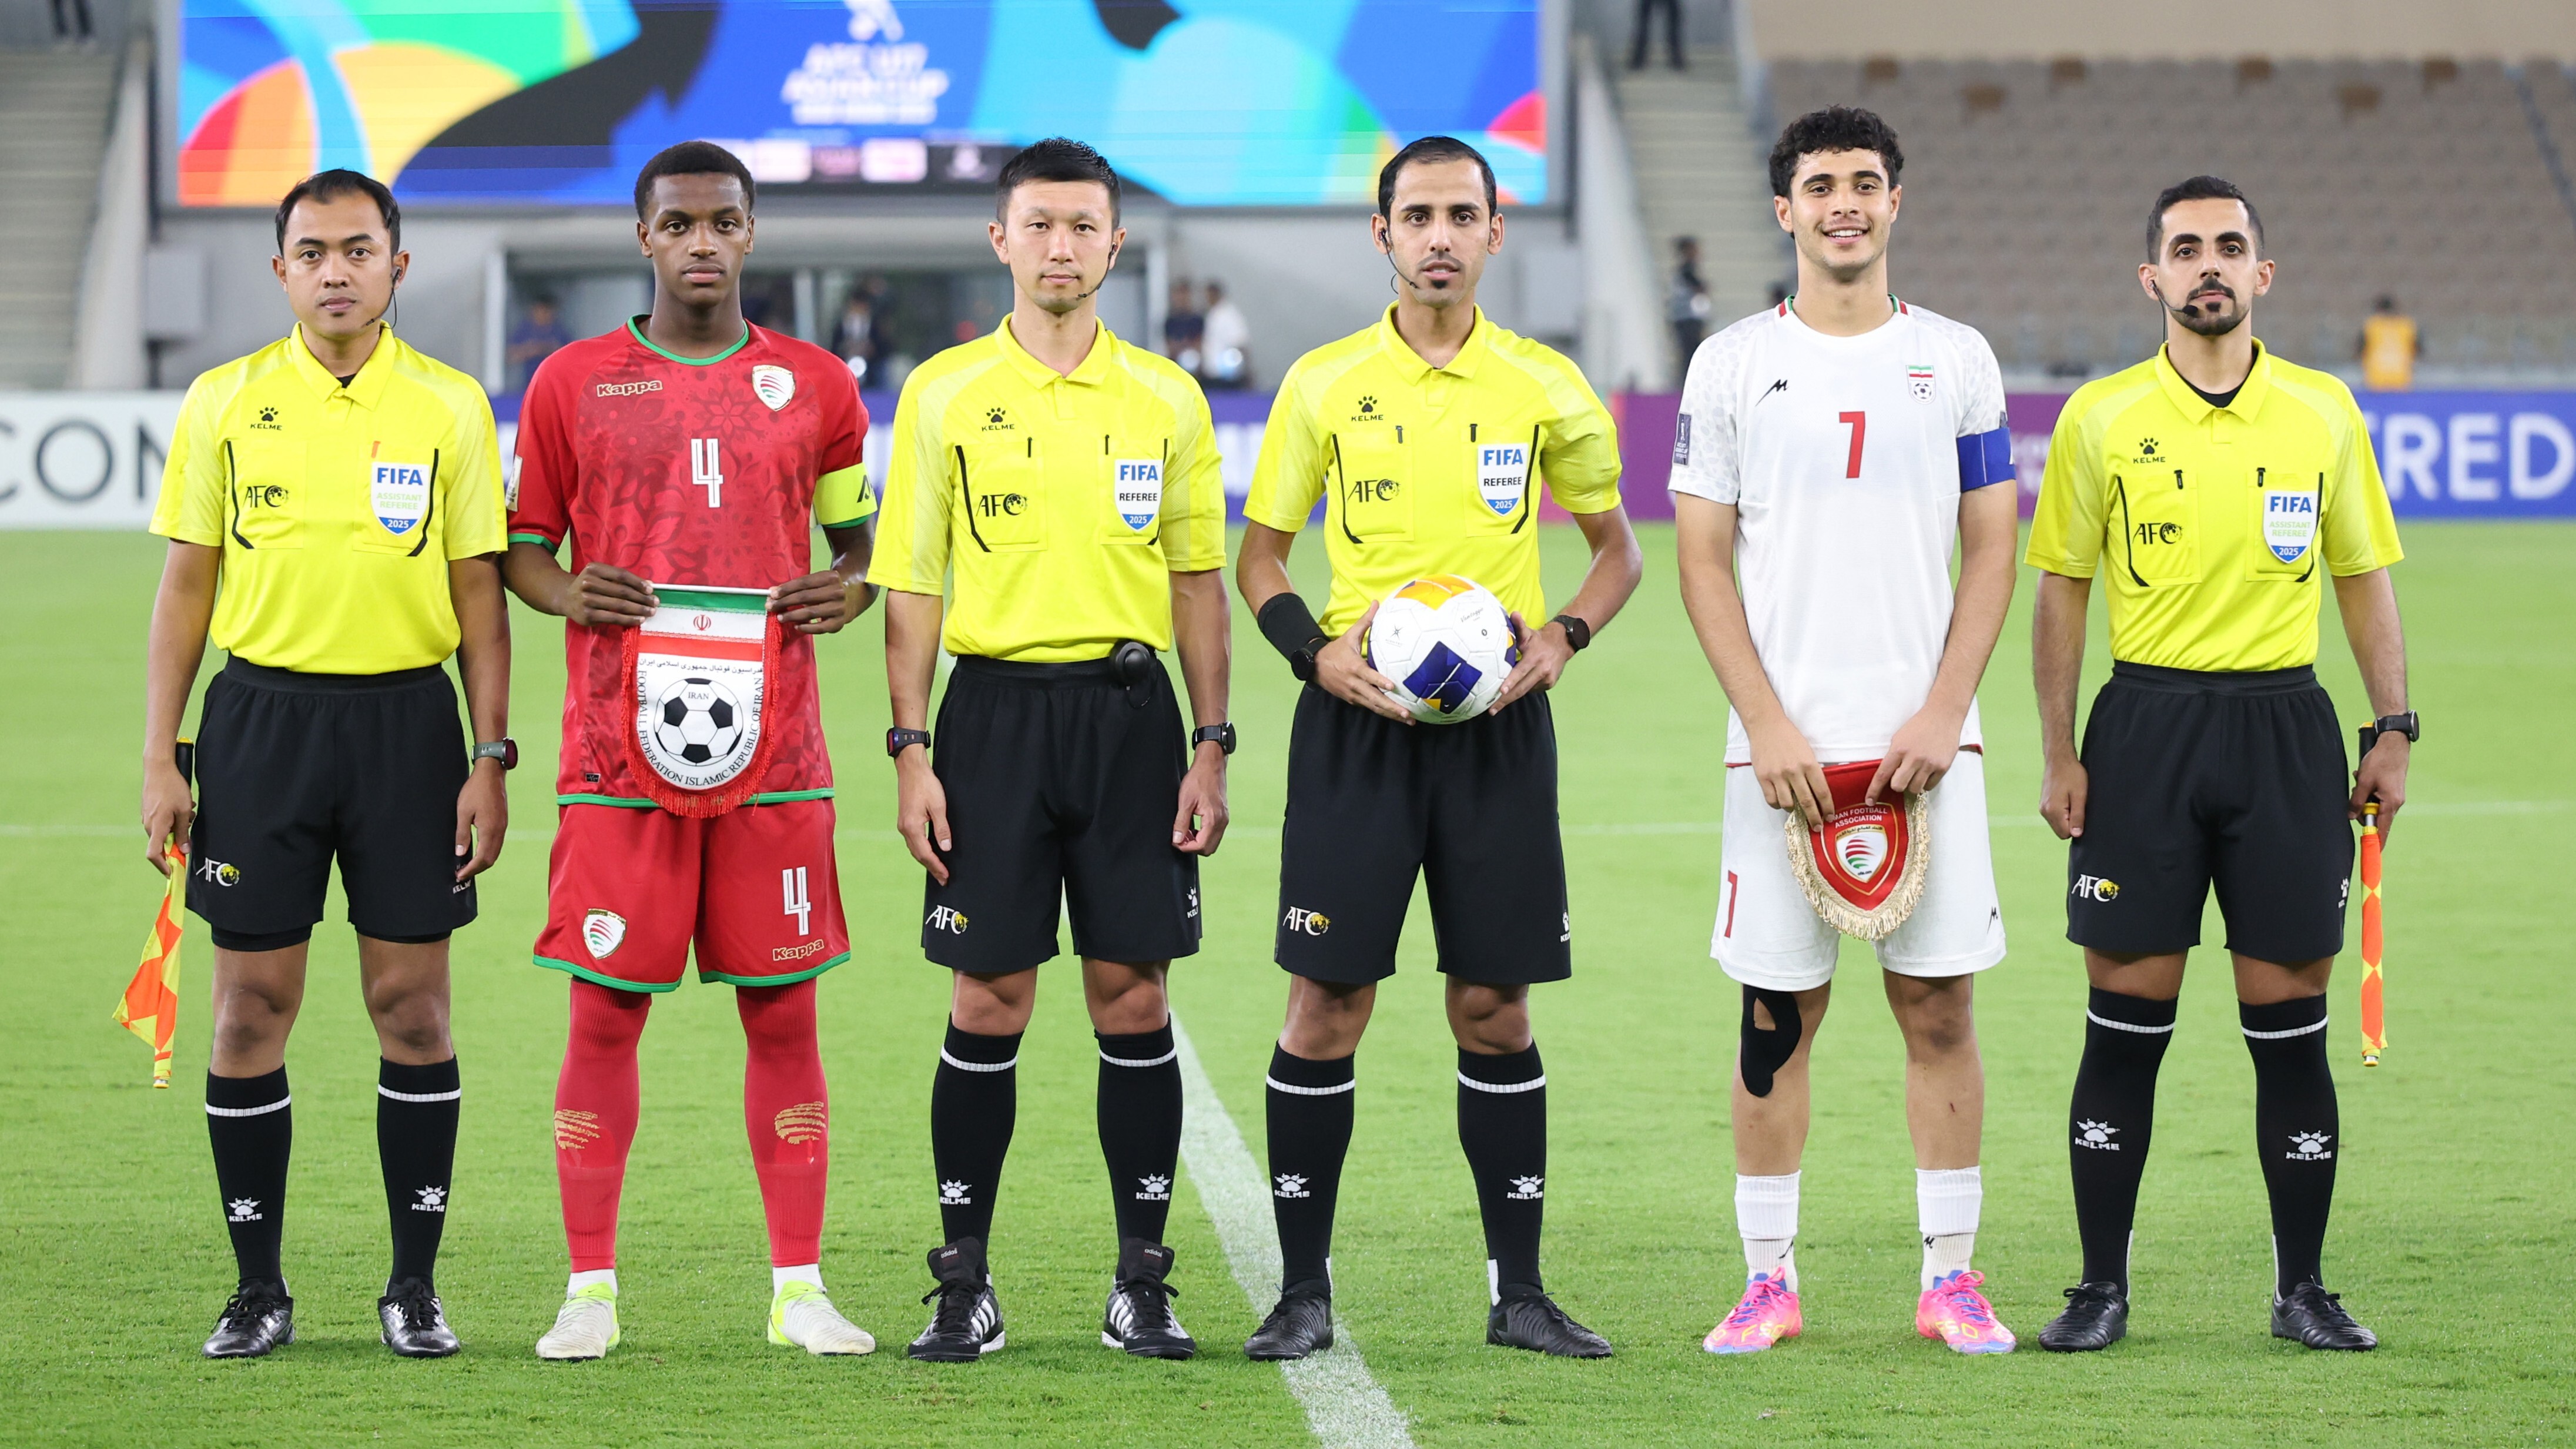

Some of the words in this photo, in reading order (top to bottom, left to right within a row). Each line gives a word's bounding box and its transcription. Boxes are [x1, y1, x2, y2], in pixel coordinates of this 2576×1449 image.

[597, 380, 663, 397] Kappa
[1838, 411, 1866, 479] 7
[1483, 449, 1523, 466] FIFA
[2364, 410, 2575, 501] RED
[377, 467, 424, 486] FIFA
[691, 438, 723, 508] 4
[1120, 464, 1158, 481] FIFA
[1483, 476, 1522, 487] REFEREE
[243, 485, 289, 508] AFC
[376, 492, 423, 501] ASSISTANT
[1119, 493, 1157, 501] REFEREE
[1347, 478, 1401, 503] AFC
[380, 500, 418, 510] REFEREE
[976, 493, 1028, 517] AFC
[1494, 500, 1513, 510] 2025
[2270, 496, 2312, 513] FIFA
[387, 519, 409, 528] 2025
[1128, 516, 1147, 524] 2025
[2269, 521, 2311, 529] ASSISTANT
[2132, 522, 2183, 545] AFC
[2272, 529, 2307, 537] REFEREE
[2278, 547, 2299, 556] 2025
[637, 670, 648, 727] FOOTBALL
[688, 691, 709, 700] IRAN
[753, 676, 764, 705] IRAN
[751, 706, 762, 722] OF
[639, 729, 684, 784] FEDERATION
[729, 724, 759, 773] REPUBLIC
[685, 769, 731, 787] ISLAMIC
[1834, 811, 1848, 821] MAN
[1850, 807, 1888, 816] FOOTBALL
[1835, 815, 1882, 829] ASSOCIATION
[195, 856, 240, 887] AFC
[2071, 874, 2120, 902] AFC
[782, 866, 812, 936] 4
[1723, 871, 1738, 938] 7
[925, 904, 969, 935] AFC
[1282, 906, 1331, 936] AFC
[772, 939, 825, 961] Kappa
[2074, 1136, 2121, 1151] KELME
[2285, 1150, 2333, 1162] KELME
[939, 1196, 972, 1205] KELME
[1135, 1191, 1170, 1202] KELME
[1274, 1189, 1311, 1199] KELME
[1506, 1191, 1544, 1200] KELME
[411, 1203, 446, 1213] KELME
[228, 1213, 263, 1222] KELME
[940, 1247, 958, 1259] adidas
[1144, 1248, 1163, 1259] adidas
